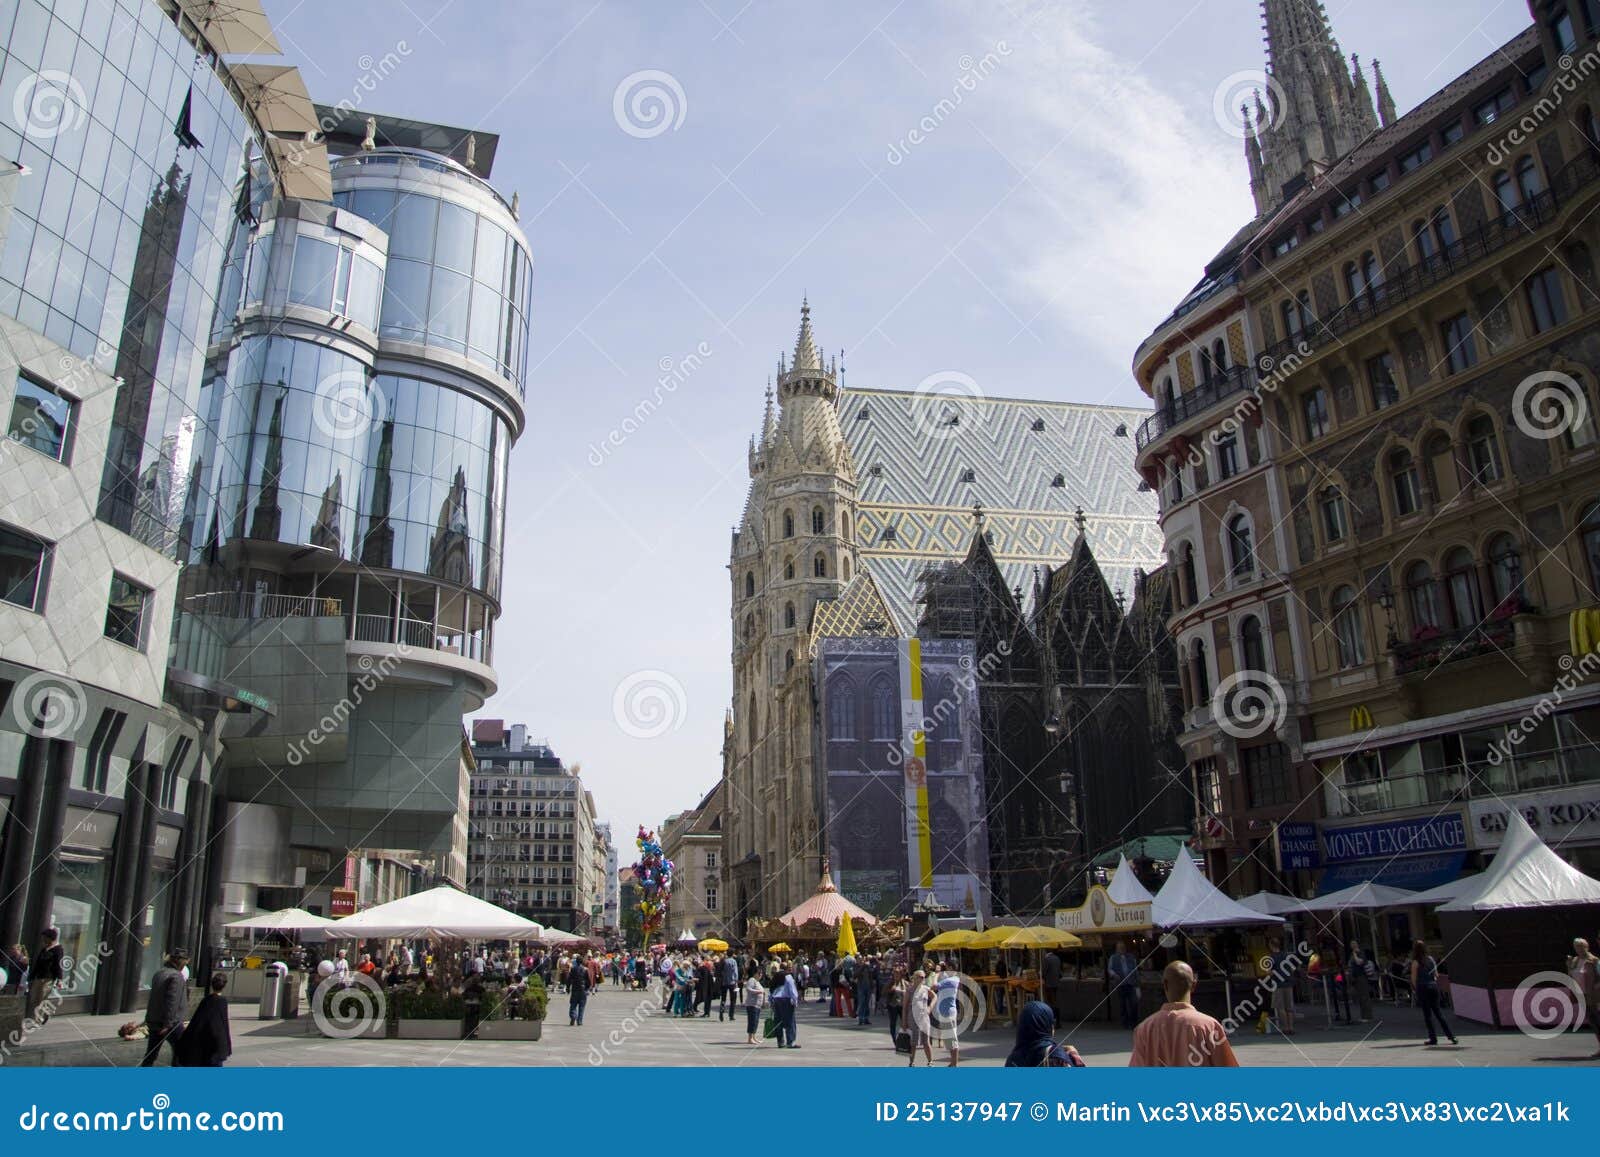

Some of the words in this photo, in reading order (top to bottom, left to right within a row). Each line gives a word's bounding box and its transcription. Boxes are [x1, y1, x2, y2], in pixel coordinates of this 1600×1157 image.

[1480, 806, 1539, 832] CAE
[1281, 840, 1320, 852] CHANGE
[1323, 831, 1373, 858] MONEY
[1377, 820, 1465, 853] EXCHANGE
[1060, 911, 1083, 928] Steffl
[1114, 908, 1145, 924] Kirtag
